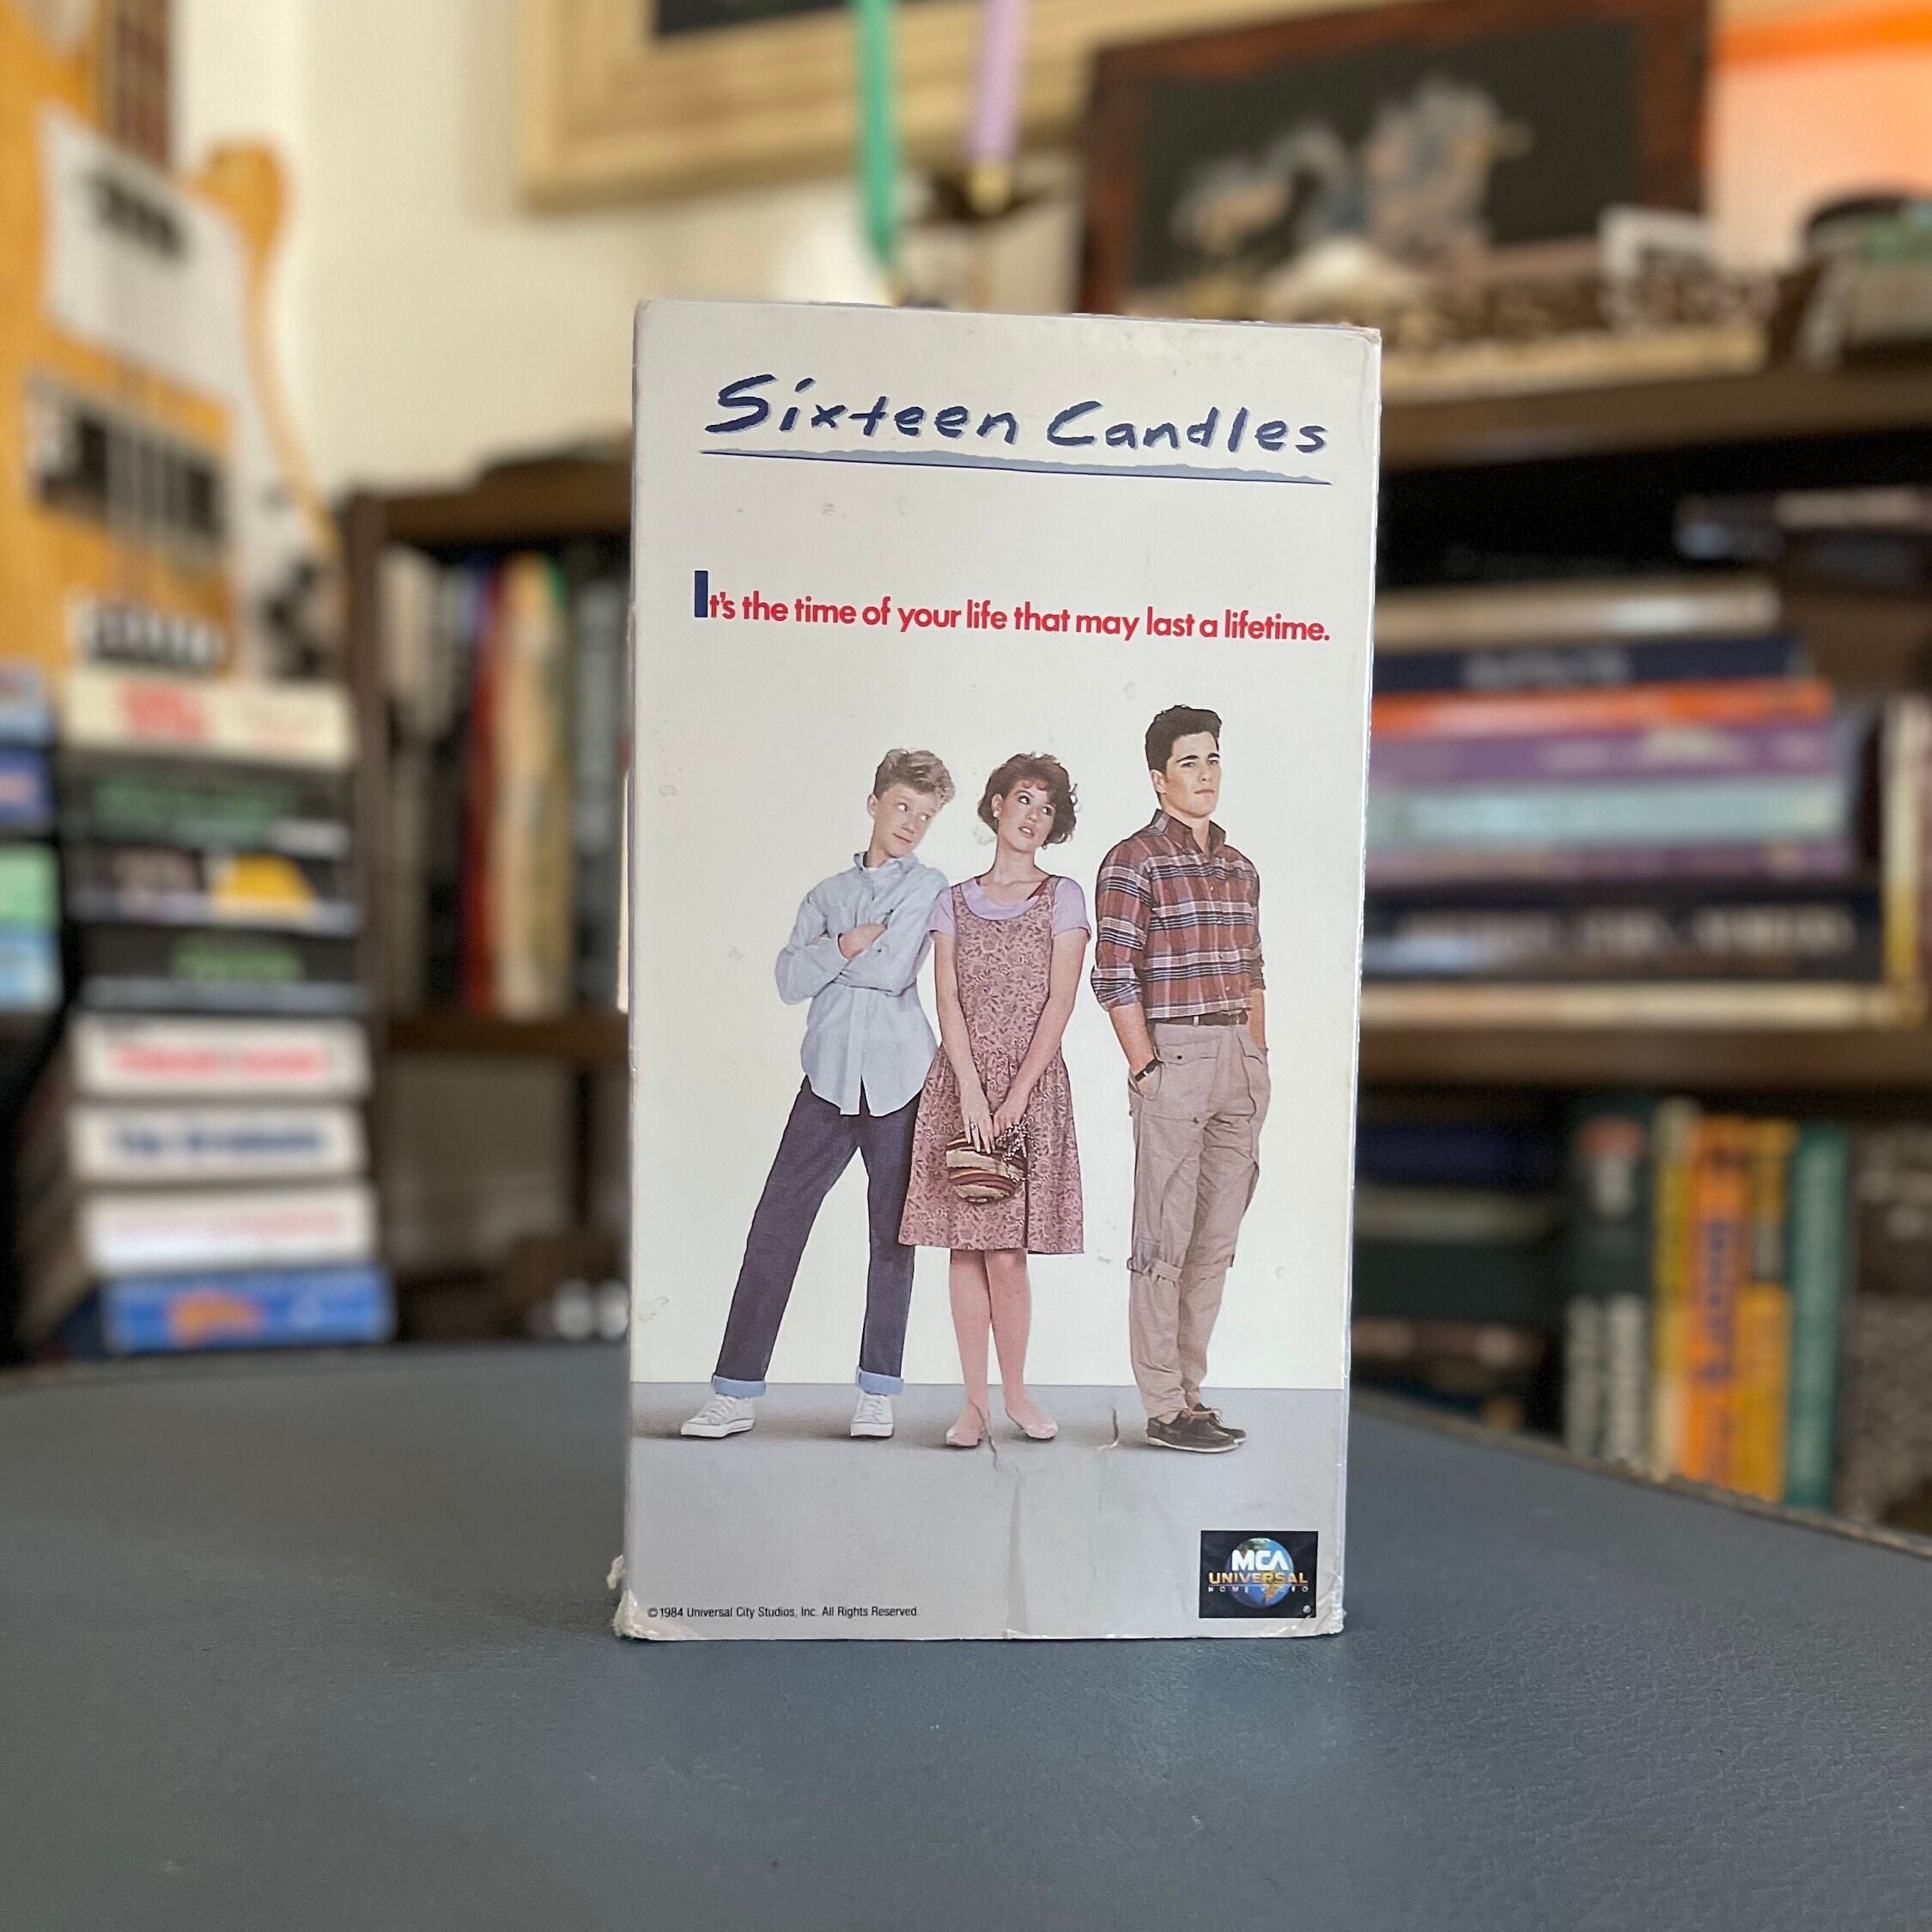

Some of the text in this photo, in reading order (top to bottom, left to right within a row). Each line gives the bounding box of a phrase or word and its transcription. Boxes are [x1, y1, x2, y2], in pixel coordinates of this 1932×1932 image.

[704, 374, 1329, 454] Sixteen Candles
[694, 570, 1330, 641] It's the time of your life that may last a lifetime.
[1231, 1549, 1289, 1571] MCA
[1208, 1572, 1309, 1585] UNIVERSAL
[686, 1607, 733, 1618] Universal
[736, 1606, 755, 1619] City
[757, 1606, 798, 1619] Studios,
[821, 1606, 835, 1617] All
[837, 1606, 869, 1619] Rights
